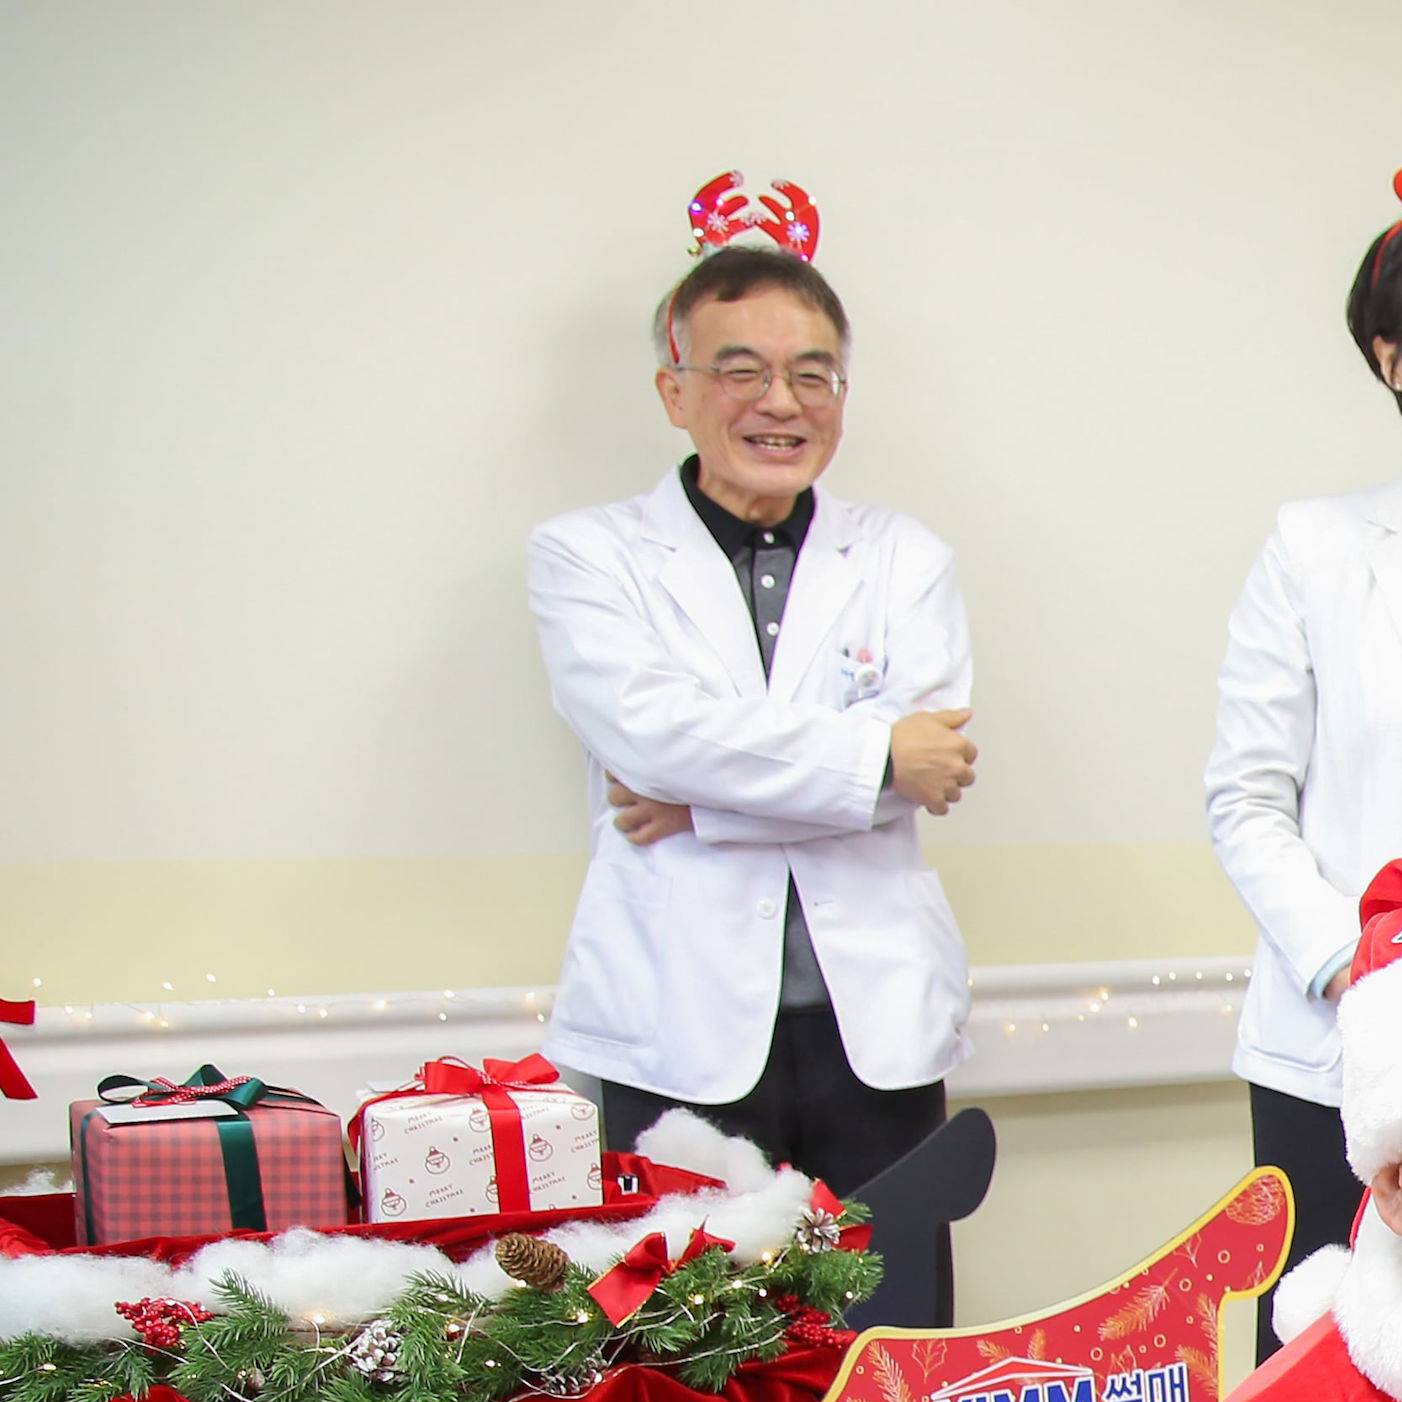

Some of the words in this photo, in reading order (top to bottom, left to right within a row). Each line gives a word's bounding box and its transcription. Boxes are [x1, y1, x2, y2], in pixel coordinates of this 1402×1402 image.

[404, 1116, 443, 1135] CHRISTMAS
[425, 1189, 464, 1208] CHRISTMAS
[429, 1184, 453, 1197] MERRY
